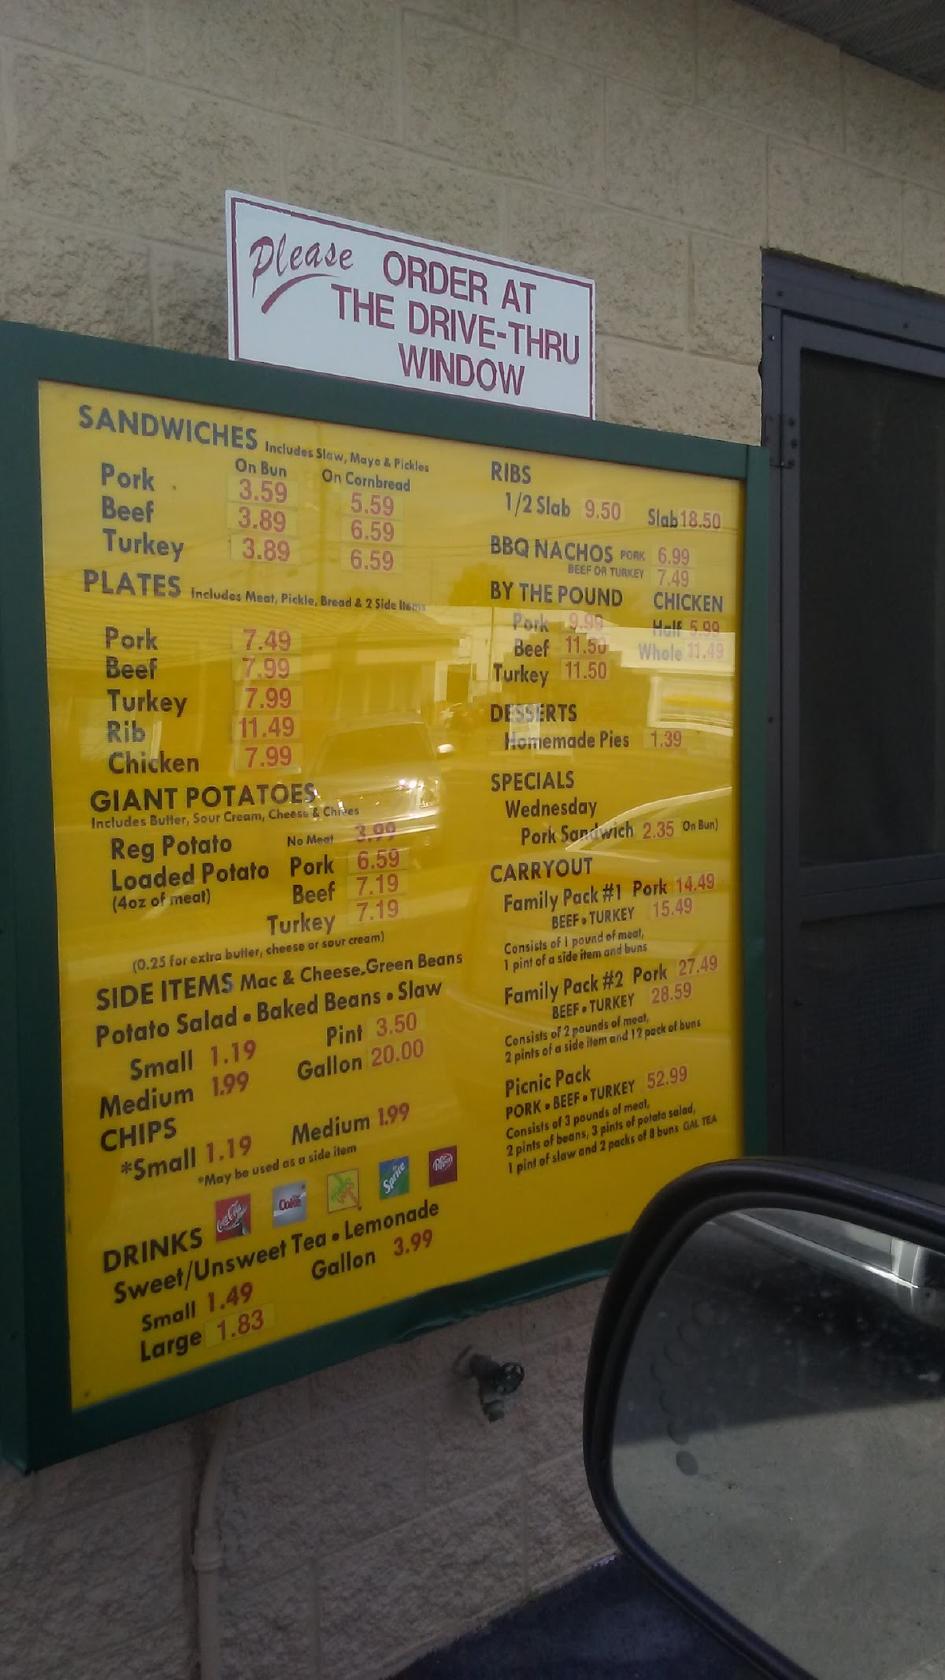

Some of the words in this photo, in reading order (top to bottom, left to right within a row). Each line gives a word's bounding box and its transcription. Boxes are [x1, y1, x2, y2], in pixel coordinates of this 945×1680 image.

[249, 232, 354, 298] Please
[383, 251, 488, 305] ORDER
[501, 280, 537, 314] AT
[331, 283, 395, 329] THE
[409, 301, 580, 364] DRIVE-THRU
[399, 343, 525, 395] WINDOW
[79, 405, 258, 450] SANDWICHES
[235, 459, 256, 474] On
[261, 461, 287, 477] Bun
[265, 442, 313, 458] Includes
[316, 448, 348, 464] Slaw,
[383, 457, 391, 467] &
[394, 458, 429, 472] Pickles
[491, 461, 531, 484] RIBS
[101, 463, 154, 491] Pork
[239, 479, 288, 503] 3.59
[351, 492, 394, 516] 5.59
[322, 469, 341, 484] On
[346, 472, 410, 492] Cornbread
[101, 496, 154, 523] Beef
[238, 506, 286, 532] 3.89
[351, 519, 394, 542] 6.59
[505, 492, 532, 517] 1/2
[537, 495, 571, 517] Slab
[585, 500, 621, 520] 9.50
[648, 508, 677, 528] Slab
[680, 511, 720, 529] 18.50
[102, 528, 184, 562] Turkey
[242, 538, 290, 561] 3.89
[351, 549, 394, 571] 6.59
[490, 535, 529, 557] BBQ
[535, 539, 613, 563] NACHOS
[658, 547, 689, 566] 6.99
[84, 569, 181, 598] PLATES
[490, 581, 514, 601] BY
[519, 583, 552, 603] THE
[558, 585, 623, 606] POUND
[658, 569, 689, 587] 7.49
[653, 592, 723, 612] CHICKEN
[106, 626, 158, 650] Pork
[243, 629, 291, 650] 7.49
[513, 612, 548, 633] Pork
[653, 620, 682, 637] Half
[690, 620, 719, 636] 5.99
[514, 639, 549, 657] Beef
[566, 637, 607, 654] 11.50
[638, 643, 683, 661] Whole
[106, 656, 158, 680] Beef
[242, 656, 290, 680] 7.99
[493, 663, 548, 687] Turkey
[565, 661, 607, 679] 11.50
[107, 688, 188, 717] Turkey
[245, 688, 291, 709] 7.99
[490, 704, 577, 722] DESSERTS
[107, 720, 145, 744] Rib
[239, 716, 294, 740] 11.49
[505, 731, 595, 750] Homemade
[600, 732, 629, 748] Pies
[650, 731, 682, 747] 1.39
[109, 751, 200, 775] Chicken
[245, 747, 292, 769] 7.99
[90, 788, 178, 812] GIANT
[186, 782, 316, 809] POTATOES
[491, 771, 574, 792] SPECIALS
[505, 798, 597, 818] Wednesday
[111, 837, 155, 863] Reg
[162, 834, 232, 856] Potato
[288, 835, 303, 847] No
[307, 833, 333, 846] Meat
[521, 827, 556, 845] Pork
[561, 822, 633, 842] Sandwich
[642, 821, 674, 839] 2.35
[683, 821, 695, 831] On
[112, 861, 194, 891] Loaded
[202, 862, 270, 884] Potato
[290, 854, 334, 877] Pork
[357, 849, 400, 871] 6.59
[491, 858, 593, 883] CARRYOUT
[112, 896, 146, 913] (4oz
[151, 893, 167, 908] of
[170, 888, 211, 907] meat)
[292, 882, 336, 904] Beef
[356, 874, 399, 896] 7.19
[504, 890, 558, 912] Family
[563, 886, 598, 906] Pack
[603, 883, 621, 901] #1
[633, 879, 667, 897] Pork
[677, 873, 715, 893] 14.49
[267, 912, 336, 936] Turkey
[357, 899, 399, 922] 7.19
[552, 916, 579, 929] BEEF
[590, 907, 634, 924] TURKEY
[653, 897, 692, 917] 15.49
[96, 983, 153, 1011] SIDE
[161, 972, 233, 1004] ITEMS
[240, 972, 277, 991] Mac
[282, 969, 295, 984] &
[418, 951, 463, 971] Beans
[505, 983, 558, 1005] Family
[564, 976, 598, 995] Pack
[603, 972, 623, 990] #2
[633, 964, 667, 984] Pork
[678, 955, 718, 977] 27.49
[96, 1021, 169, 1048] Potato
[177, 1005, 237, 1035] Salad
[257, 998, 318, 1023] Baked
[325, 990, 381, 1013] Beans
[398, 979, 442, 1000] Slaw
[552, 1004, 579, 1020] BEEF
[590, 993, 634, 1013] TURKEY
[652, 982, 692, 1004] 28.59
[327, 1024, 362, 1048] Pint
[376, 1012, 417, 1038] 3.50
[130, 1051, 192, 1082] Small
[210, 1039, 257, 1068] 1.19
[297, 1052, 362, 1082] Gallon
[371, 1038, 424, 1068] 20.00
[100, 1085, 193, 1120] Medium
[212, 1071, 249, 1098] 1.99
[506, 1073, 551, 1098] Picnic
[556, 1065, 591, 1085] Pack
[506, 1101, 541, 1120] PORK
[553, 1092, 582, 1110] BEEF
[591, 1080, 635, 1101] TURKEY
[647, 1066, 688, 1089] 52.99
[100, 1118, 176, 1151] CHIPS
[292, 1113, 370, 1146] Medium
[378, 1102, 410, 1128] 1.99
[506, 1121, 550, 1139] Consists
[552, 1115, 564, 1128] of
[565, 1115, 570, 1126] 3
[574, 1107, 610, 1127] pounds
[612, 1104, 622, 1115] of
[207, 1135, 252, 1163] 1.19
[383, 1161, 406, 1194] Sprite
[103, 1227, 202, 1274] DRINKS
[114, 1239, 286, 1304] Sweet/Unsweet
[292, 1232, 327, 1255] Tea
[345, 1199, 439, 1241] Lemonade
[312, 1251, 375, 1281] Gallon
[393, 1229, 433, 1257] 3.99
[142, 1301, 196, 1332] Small
[208, 1282, 253, 1313] 1.49
[141, 1329, 202, 1362] Large
[216, 1309, 264, 1342] 1.83
